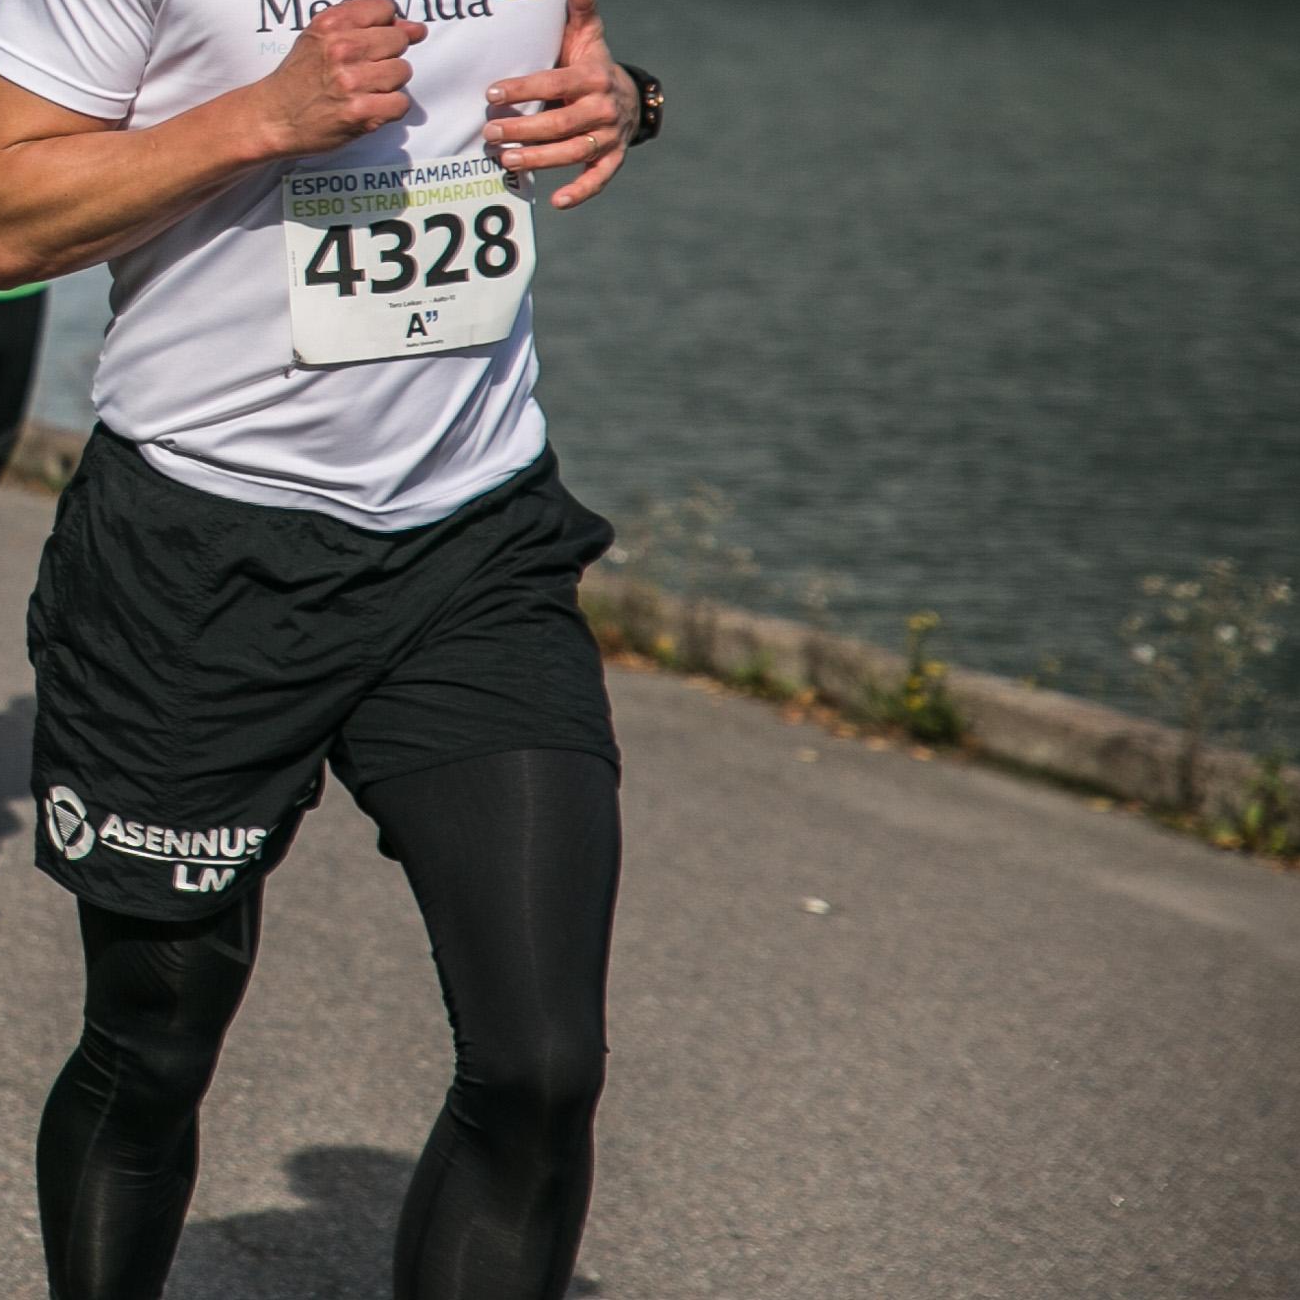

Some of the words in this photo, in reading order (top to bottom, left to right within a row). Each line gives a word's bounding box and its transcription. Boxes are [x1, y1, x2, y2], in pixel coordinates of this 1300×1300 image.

[291, 174, 358, 196] ESPOO
[364, 156, 503, 191] RANTAMARATON
[292, 198, 346, 219] ESBO
[351, 178, 505, 214] STRANDMARATON
[303, 204, 520, 298] 4328
